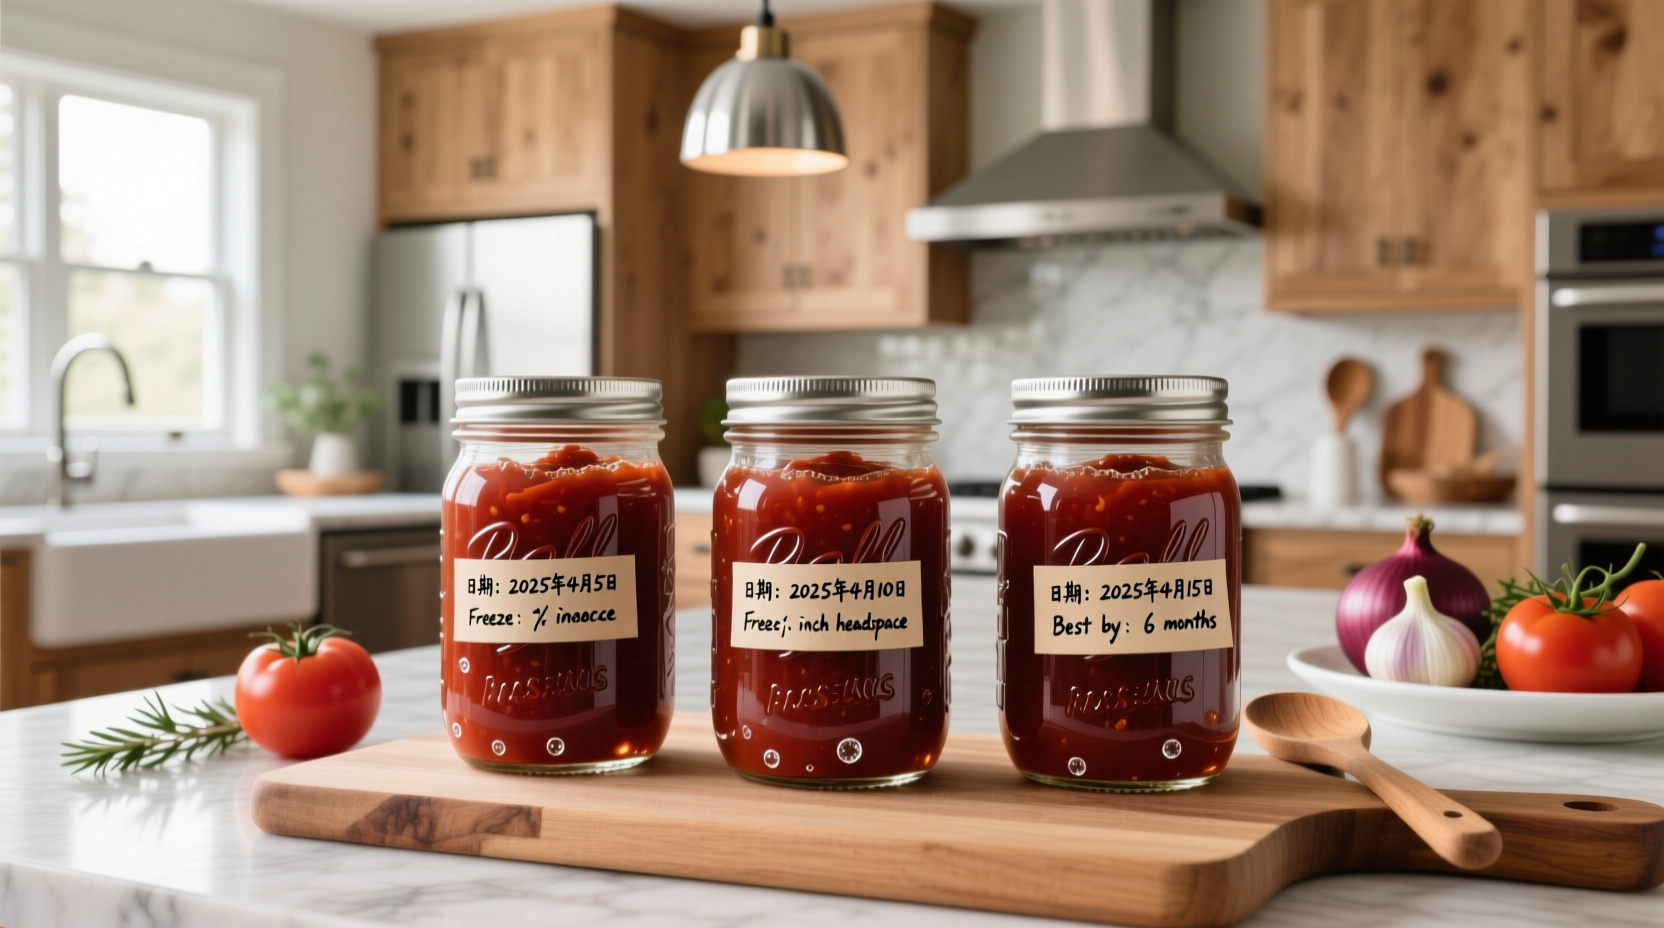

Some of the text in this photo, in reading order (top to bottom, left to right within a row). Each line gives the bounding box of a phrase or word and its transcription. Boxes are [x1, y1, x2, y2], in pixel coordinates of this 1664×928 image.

[469, 607, 521, 626] Freeze:
[799, 613, 829, 631] inch
[836, 612, 908, 641] headspace
[1052, 609, 1217, 644] Best by: 6 months
